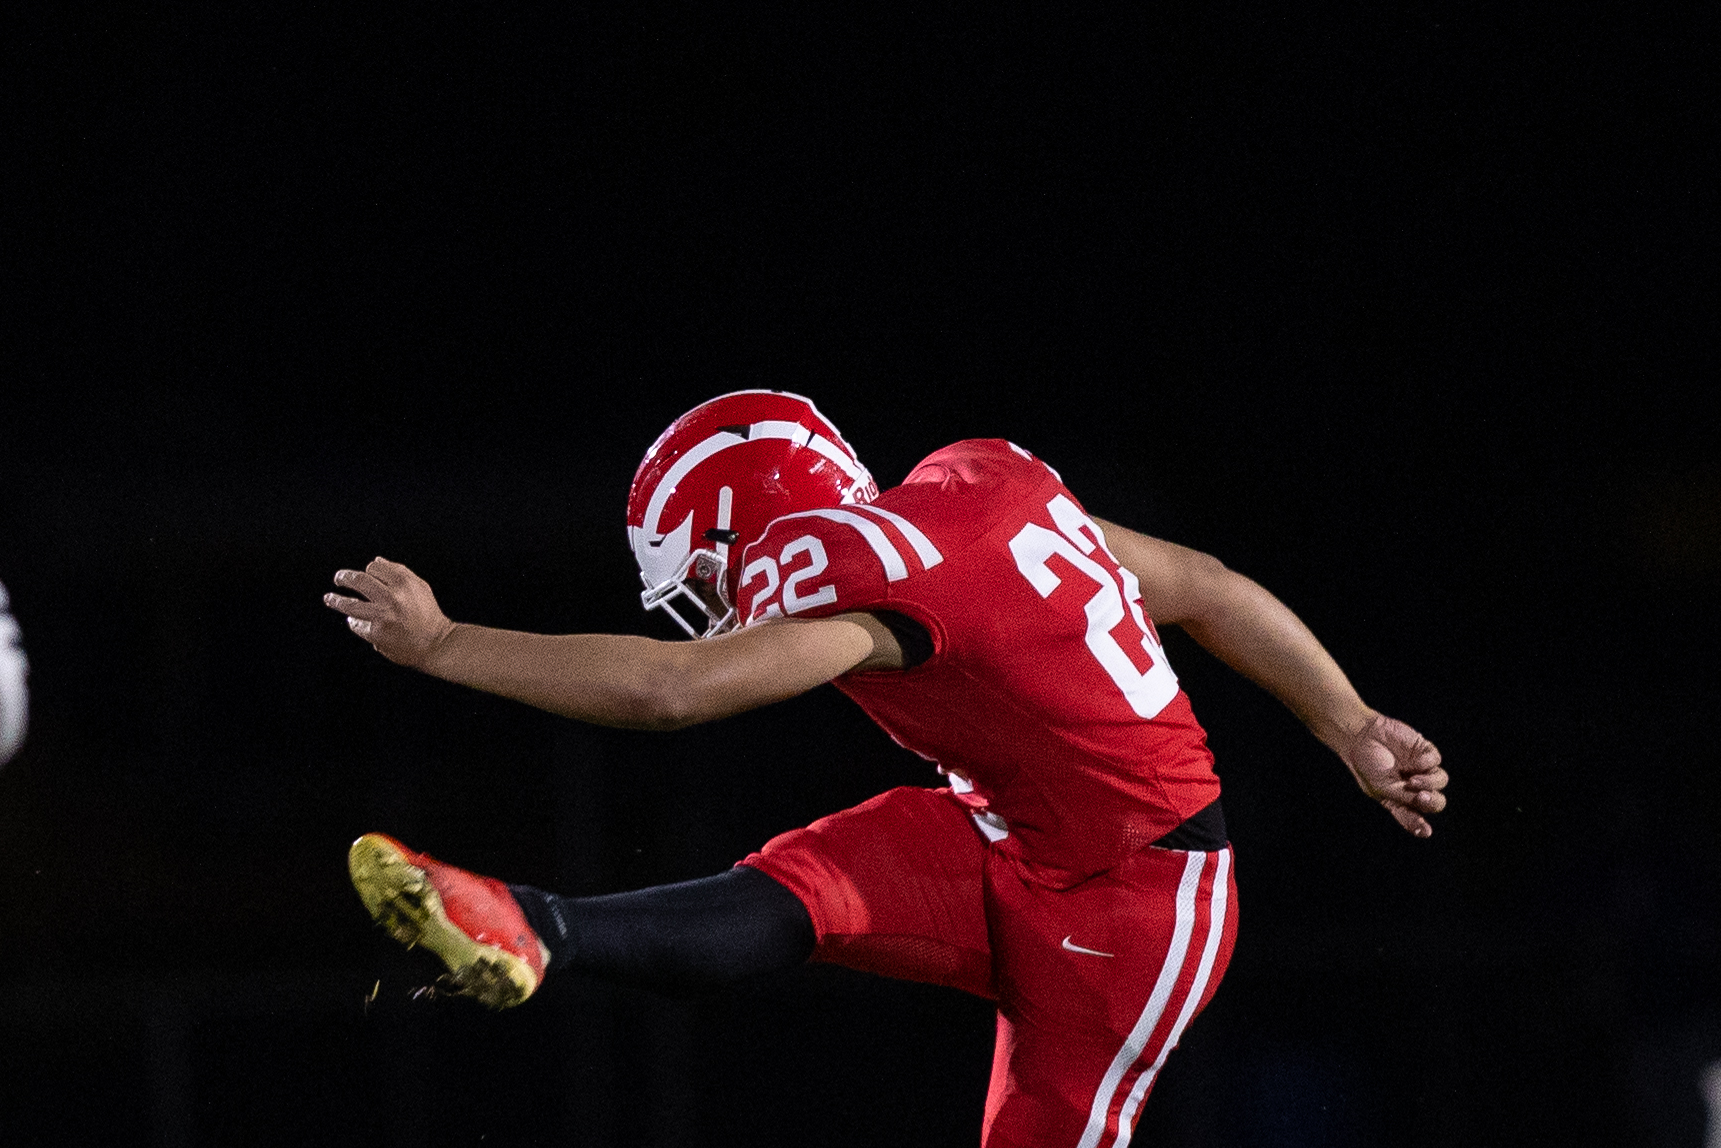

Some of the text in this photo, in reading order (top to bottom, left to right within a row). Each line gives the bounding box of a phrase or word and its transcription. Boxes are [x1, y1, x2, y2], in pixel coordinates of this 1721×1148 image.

[852, 475, 878, 505] RID
[741, 534, 838, 626] 22
[1008, 493, 1179, 720] 22
